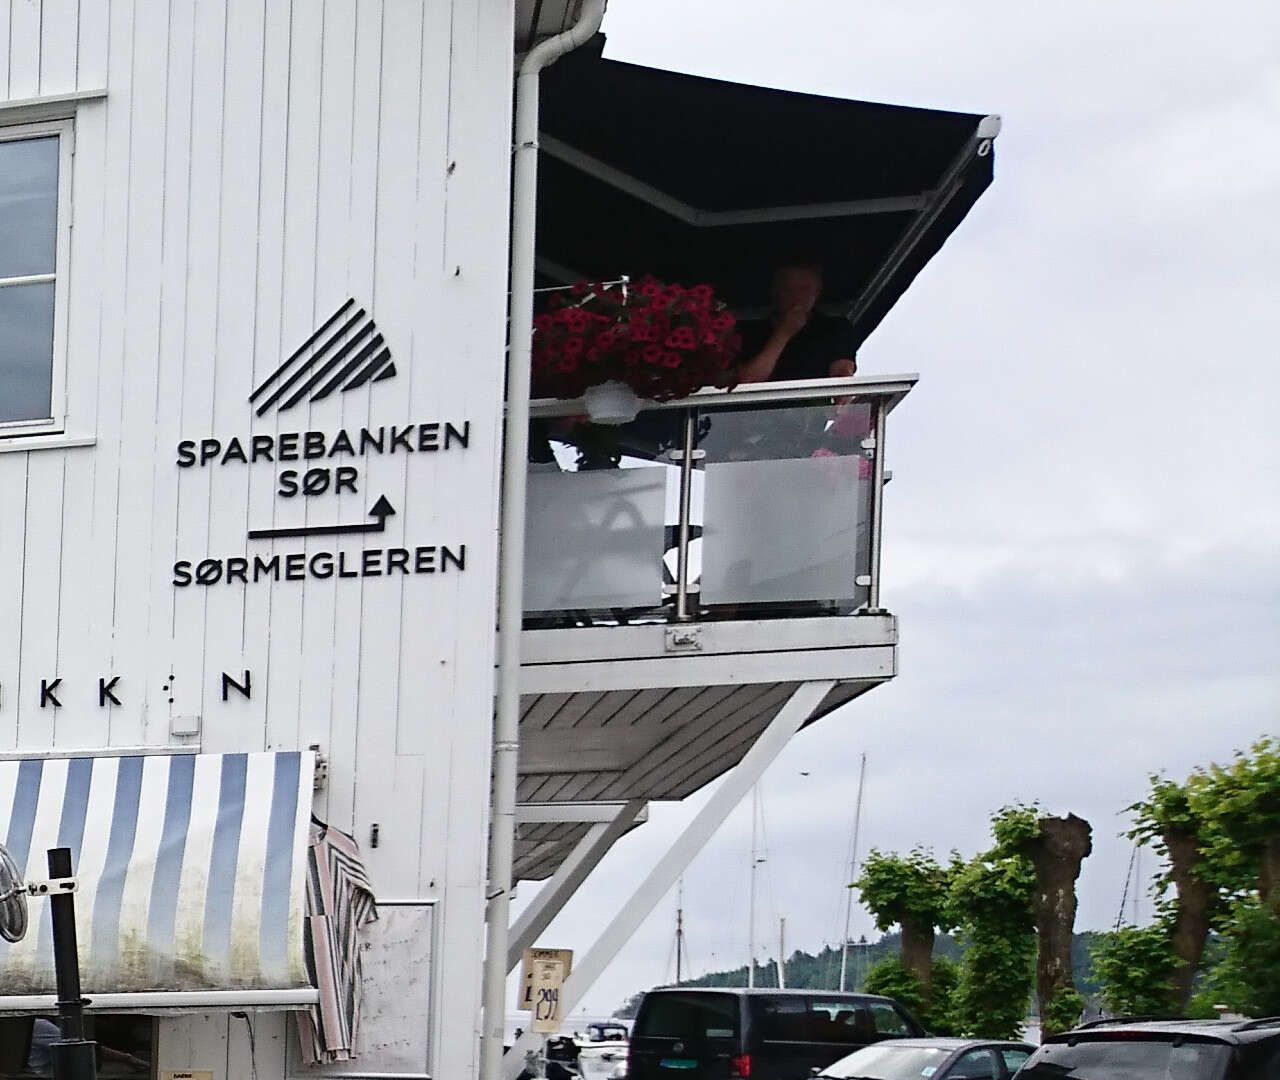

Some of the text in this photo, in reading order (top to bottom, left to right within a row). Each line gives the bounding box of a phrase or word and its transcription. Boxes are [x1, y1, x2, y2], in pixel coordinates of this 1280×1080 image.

[176, 420, 470, 468] SPAREBANKEN
[278, 466, 358, 498] SØR
[172, 544, 466, 588] SØRMEGLEREN
